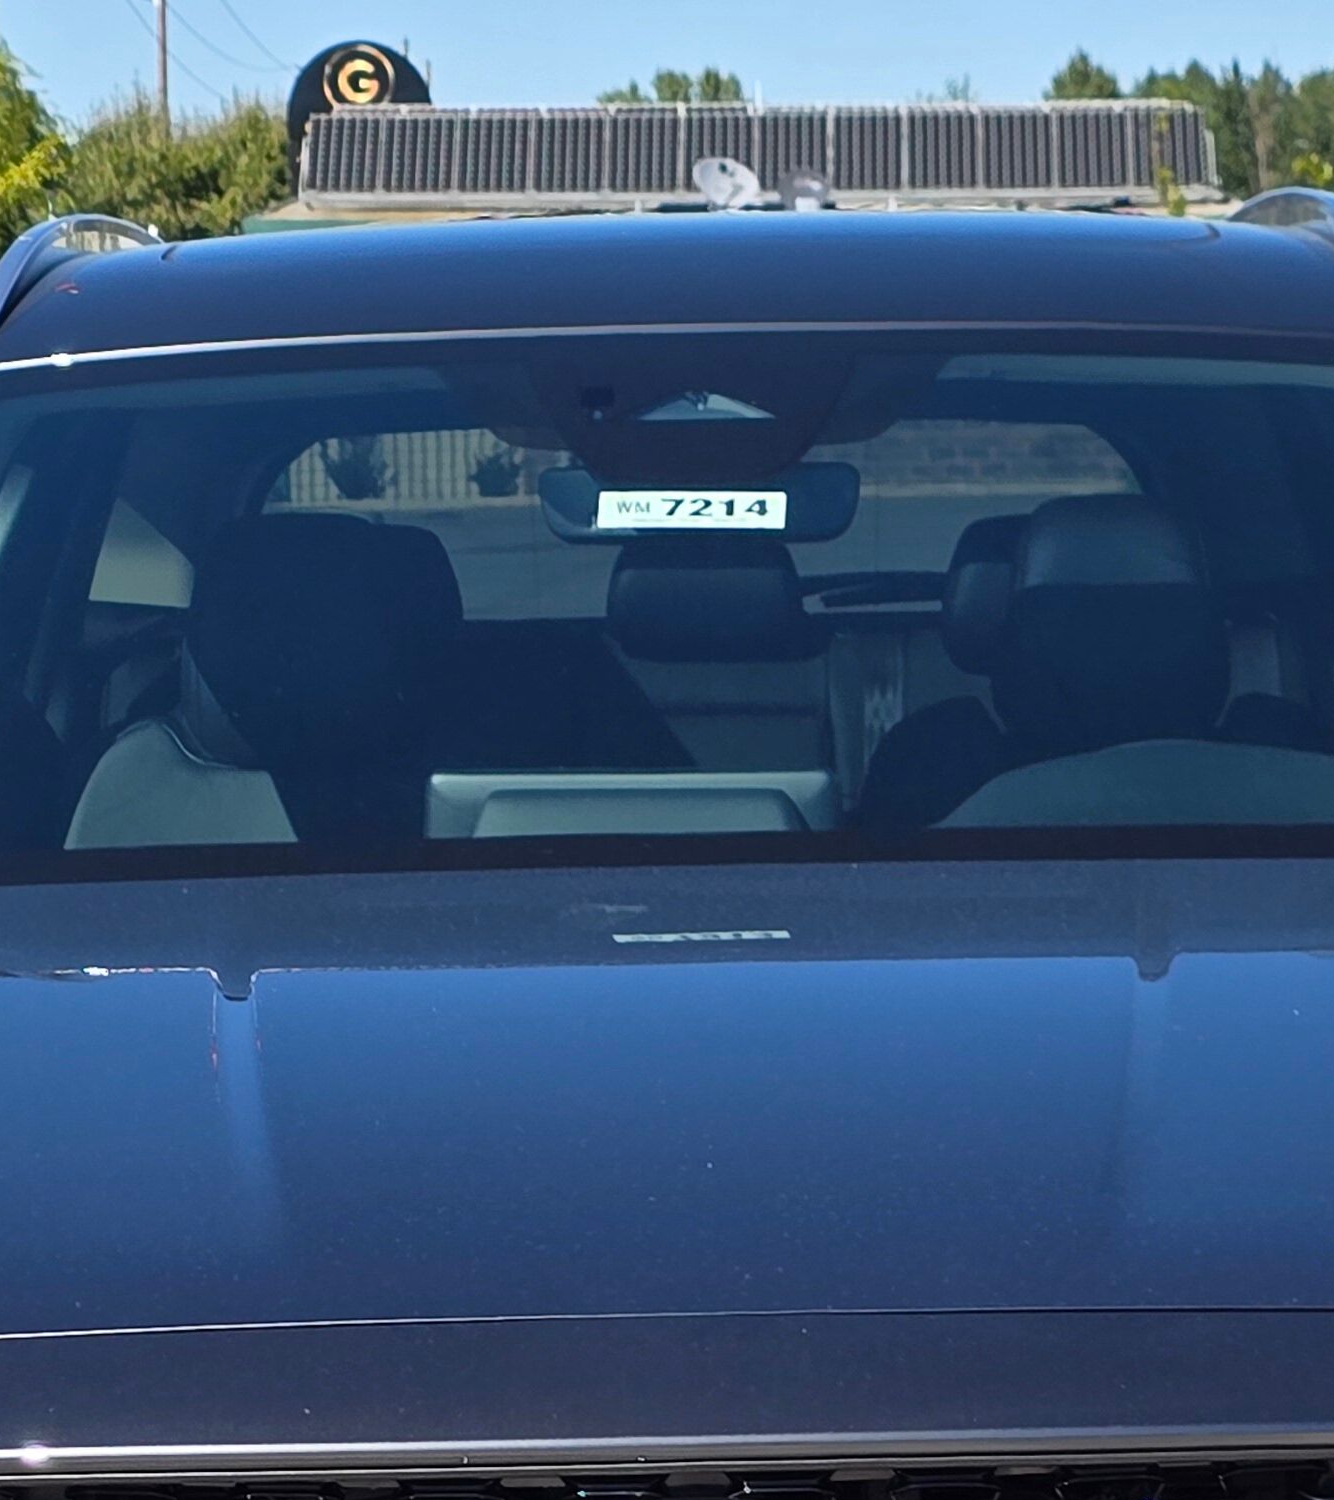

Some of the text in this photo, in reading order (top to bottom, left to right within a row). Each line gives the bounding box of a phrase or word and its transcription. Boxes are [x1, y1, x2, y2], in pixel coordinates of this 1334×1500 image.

[337, 58, 380, 104] G
[616, 498, 769, 517] WM 7214
